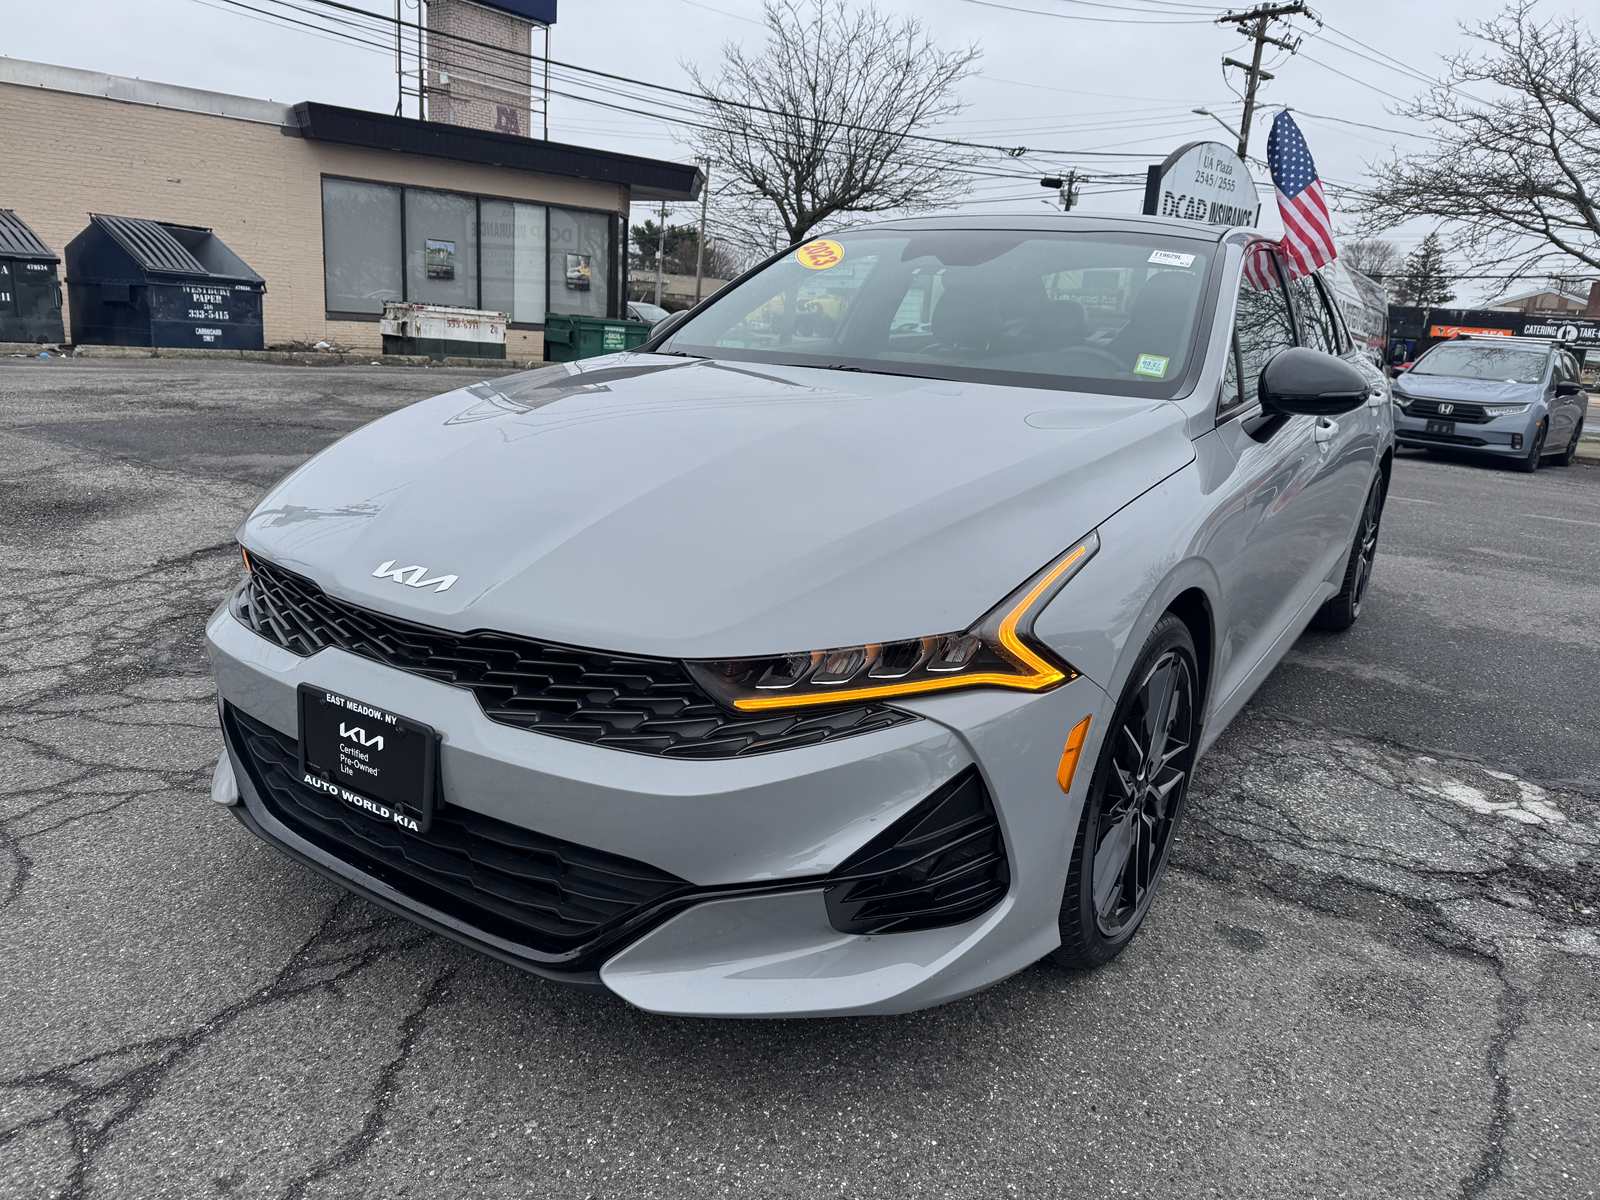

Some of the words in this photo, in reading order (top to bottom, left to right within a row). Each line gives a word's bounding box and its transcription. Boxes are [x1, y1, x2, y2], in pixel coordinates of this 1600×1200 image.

[1203, 156, 1213, 169] UA
[1215, 159, 1233, 175] Plaza
[803, 242, 838, 266] 2023
[193, 293, 222, 304] PAPER
[188, 309, 229, 320] 333-5415
[1524, 324, 1558, 336] CATERING
[372, 560, 459, 593] KIA
[326, 693, 346, 707] EAST
[385, 714, 398, 725] NY
[339, 721, 384, 751] KIA
[339, 743, 369, 762] Certified
[340, 754, 379, 777] Pre-Owned
[340, 763, 354, 776] Lite
[304, 774, 339, 796] AUTO
[341, 789, 390, 818] WORLD
[393, 813, 419, 832] KIA
